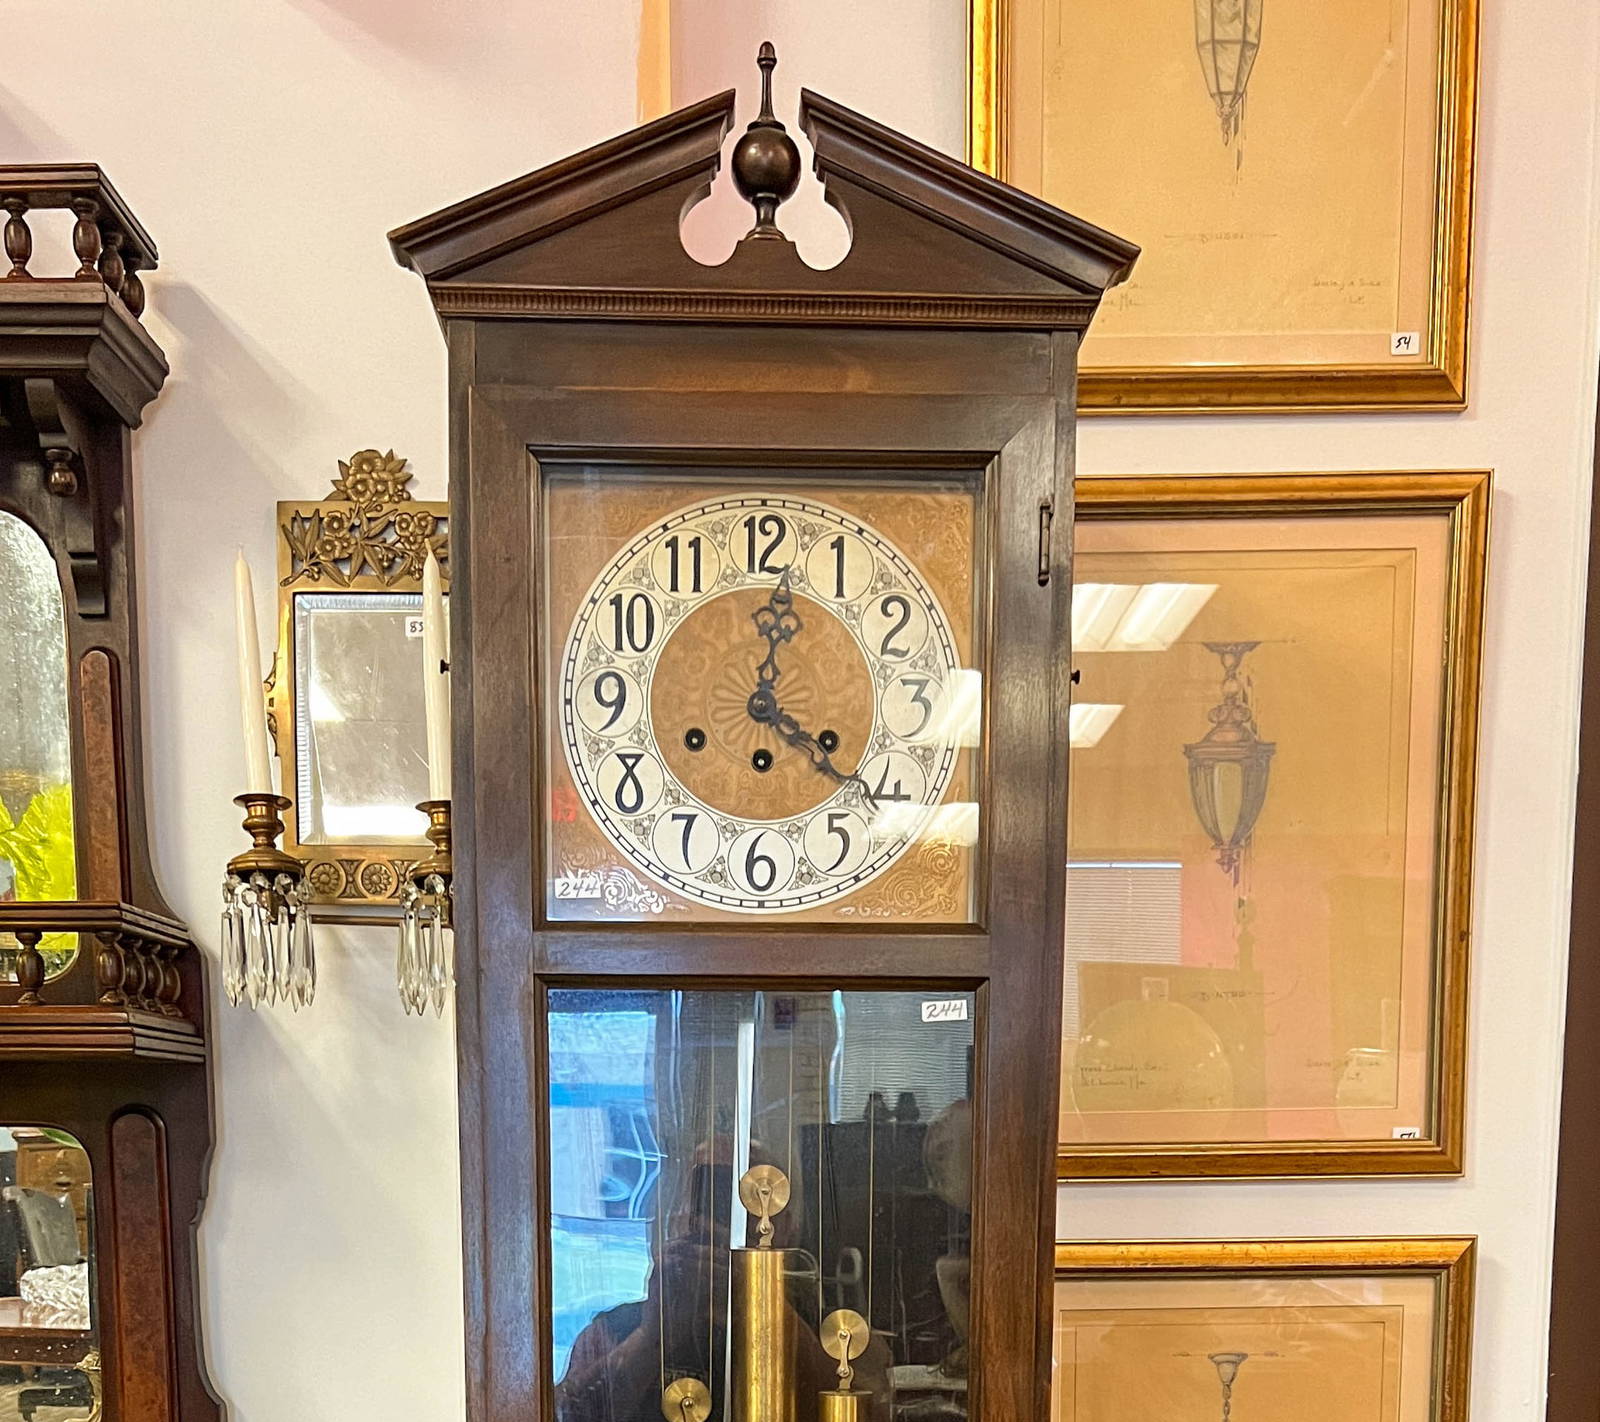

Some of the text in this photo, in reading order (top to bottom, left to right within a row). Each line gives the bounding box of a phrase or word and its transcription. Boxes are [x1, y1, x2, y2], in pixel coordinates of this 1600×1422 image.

[1395, 335, 1412, 350] 54
[664, 535, 703, 593] 11
[743, 514, 786, 574] 12
[830, 535, 846, 598] 1
[609, 593, 655, 653] 10
[880, 595, 911, 657] 2
[594, 671, 627, 732] 9
[900, 679, 932, 738] 3
[613, 753, 645, 814] 8
[868, 754, 912, 803] 4
[671, 813, 698, 870] 7
[744, 831, 777, 893] 6
[825, 813, 851, 873] 5
[558, 880, 599, 898] 244
[926, 1001, 963, 1019] 244
